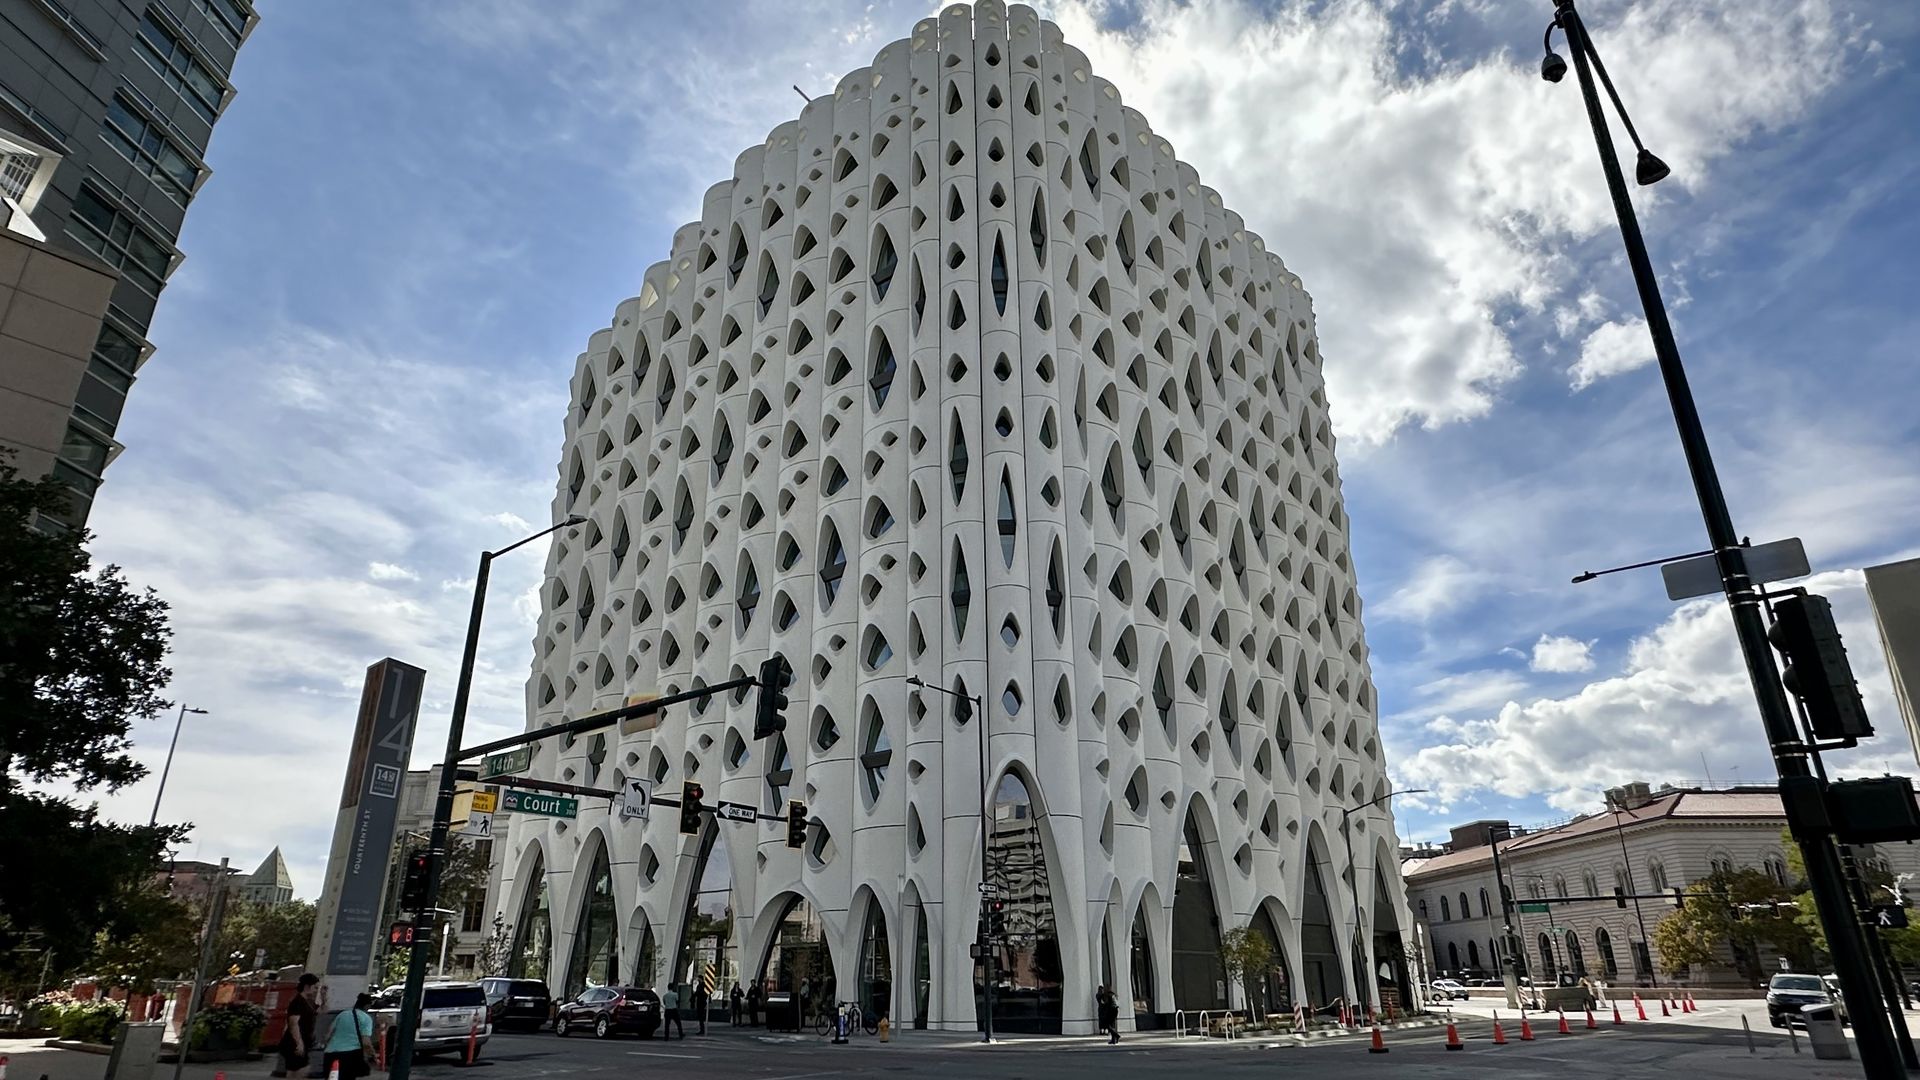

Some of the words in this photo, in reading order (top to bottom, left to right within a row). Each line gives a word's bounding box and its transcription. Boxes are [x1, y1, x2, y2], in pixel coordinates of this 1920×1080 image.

[491, 755, 513, 774] 14th
[523, 796, 561, 813] Court
[626, 805, 645, 816] ONLY
[728, 806, 741, 816] ONE
[741, 809, 753, 818] WAY
